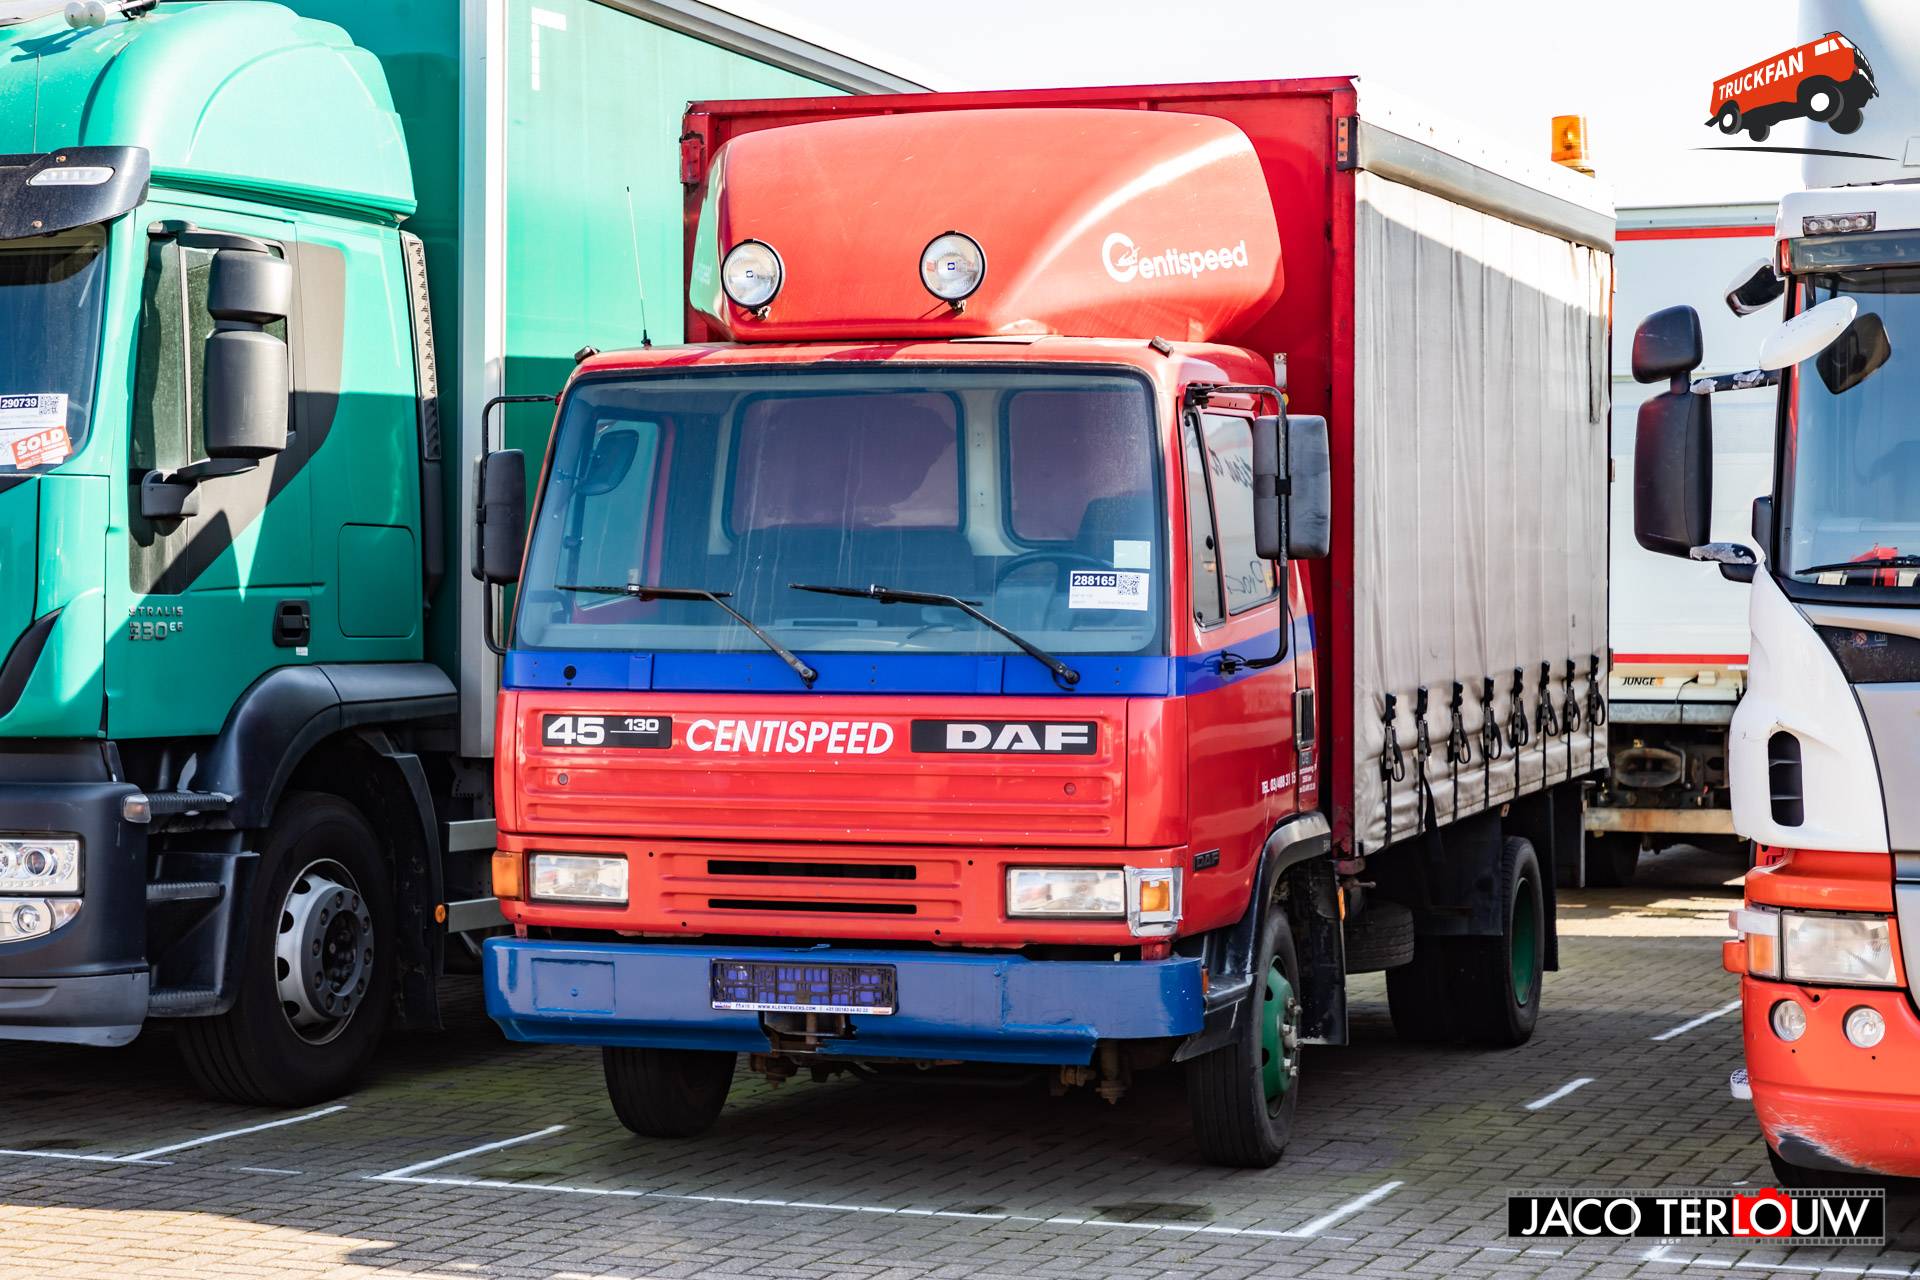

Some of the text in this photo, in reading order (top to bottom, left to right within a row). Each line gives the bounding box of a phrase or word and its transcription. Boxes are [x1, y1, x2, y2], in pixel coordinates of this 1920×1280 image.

[1101, 232, 1249, 283] Centispeed
[1, 397, 38, 409] 290739
[16, 429, 64, 456] SOLD
[1073, 575, 1115, 586] 288165
[129, 606, 183, 617] STRALIS
[547, 717, 659, 745] 45 130
[686, 719, 894, 754] CENTISPEED
[946, 723, 1089, 751] DAF
[1197, 851, 1218, 868] DAF
